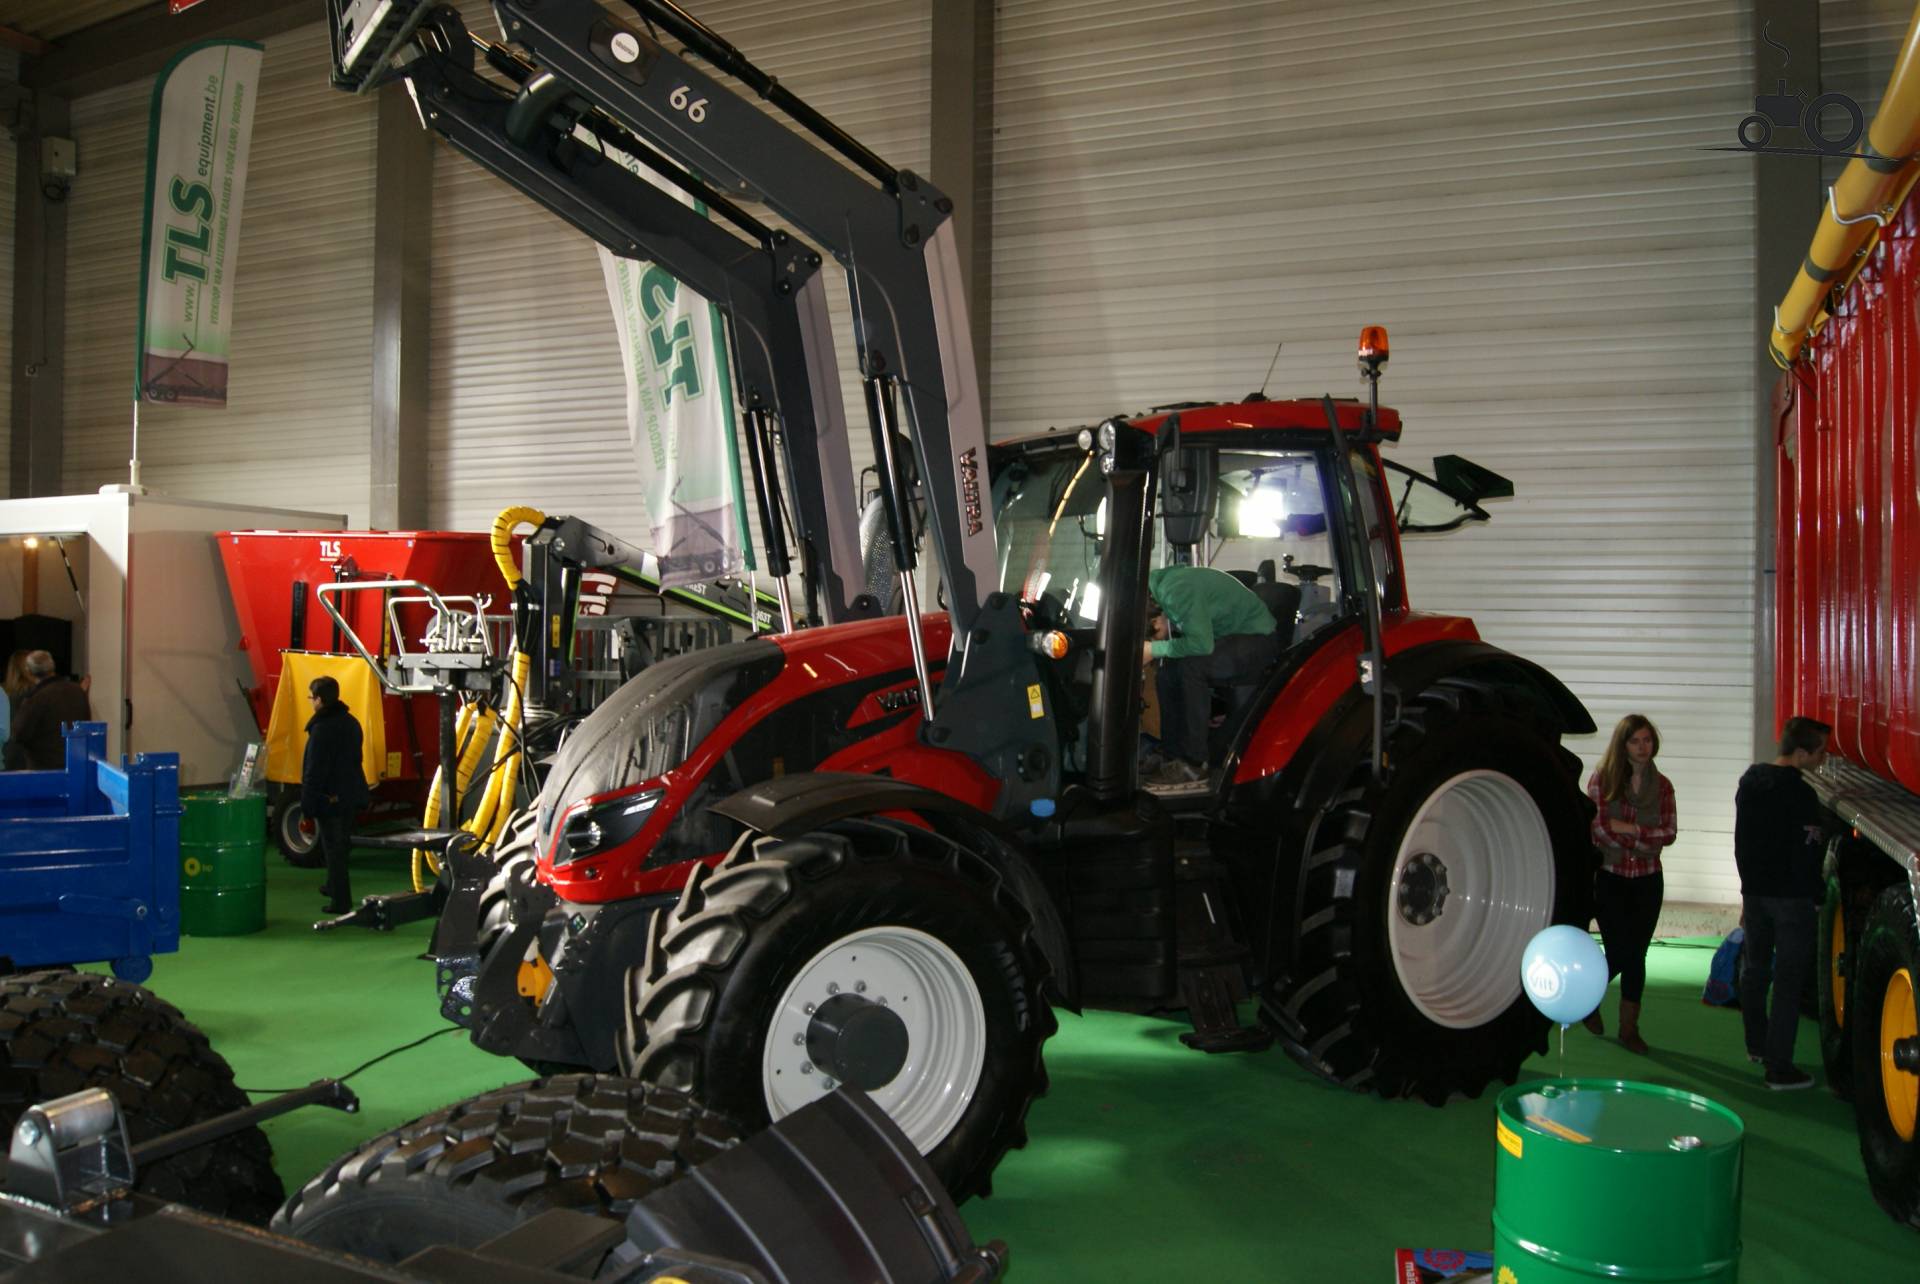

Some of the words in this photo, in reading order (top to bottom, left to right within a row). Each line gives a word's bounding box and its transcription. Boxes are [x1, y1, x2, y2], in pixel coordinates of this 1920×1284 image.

[669, 86, 709, 123] 66
[162, 174, 217, 285] TLS
[198, 75, 219, 177] equipment.be
[959, 447, 984, 537] VALTRA
[319, 540, 341, 557] TLS
